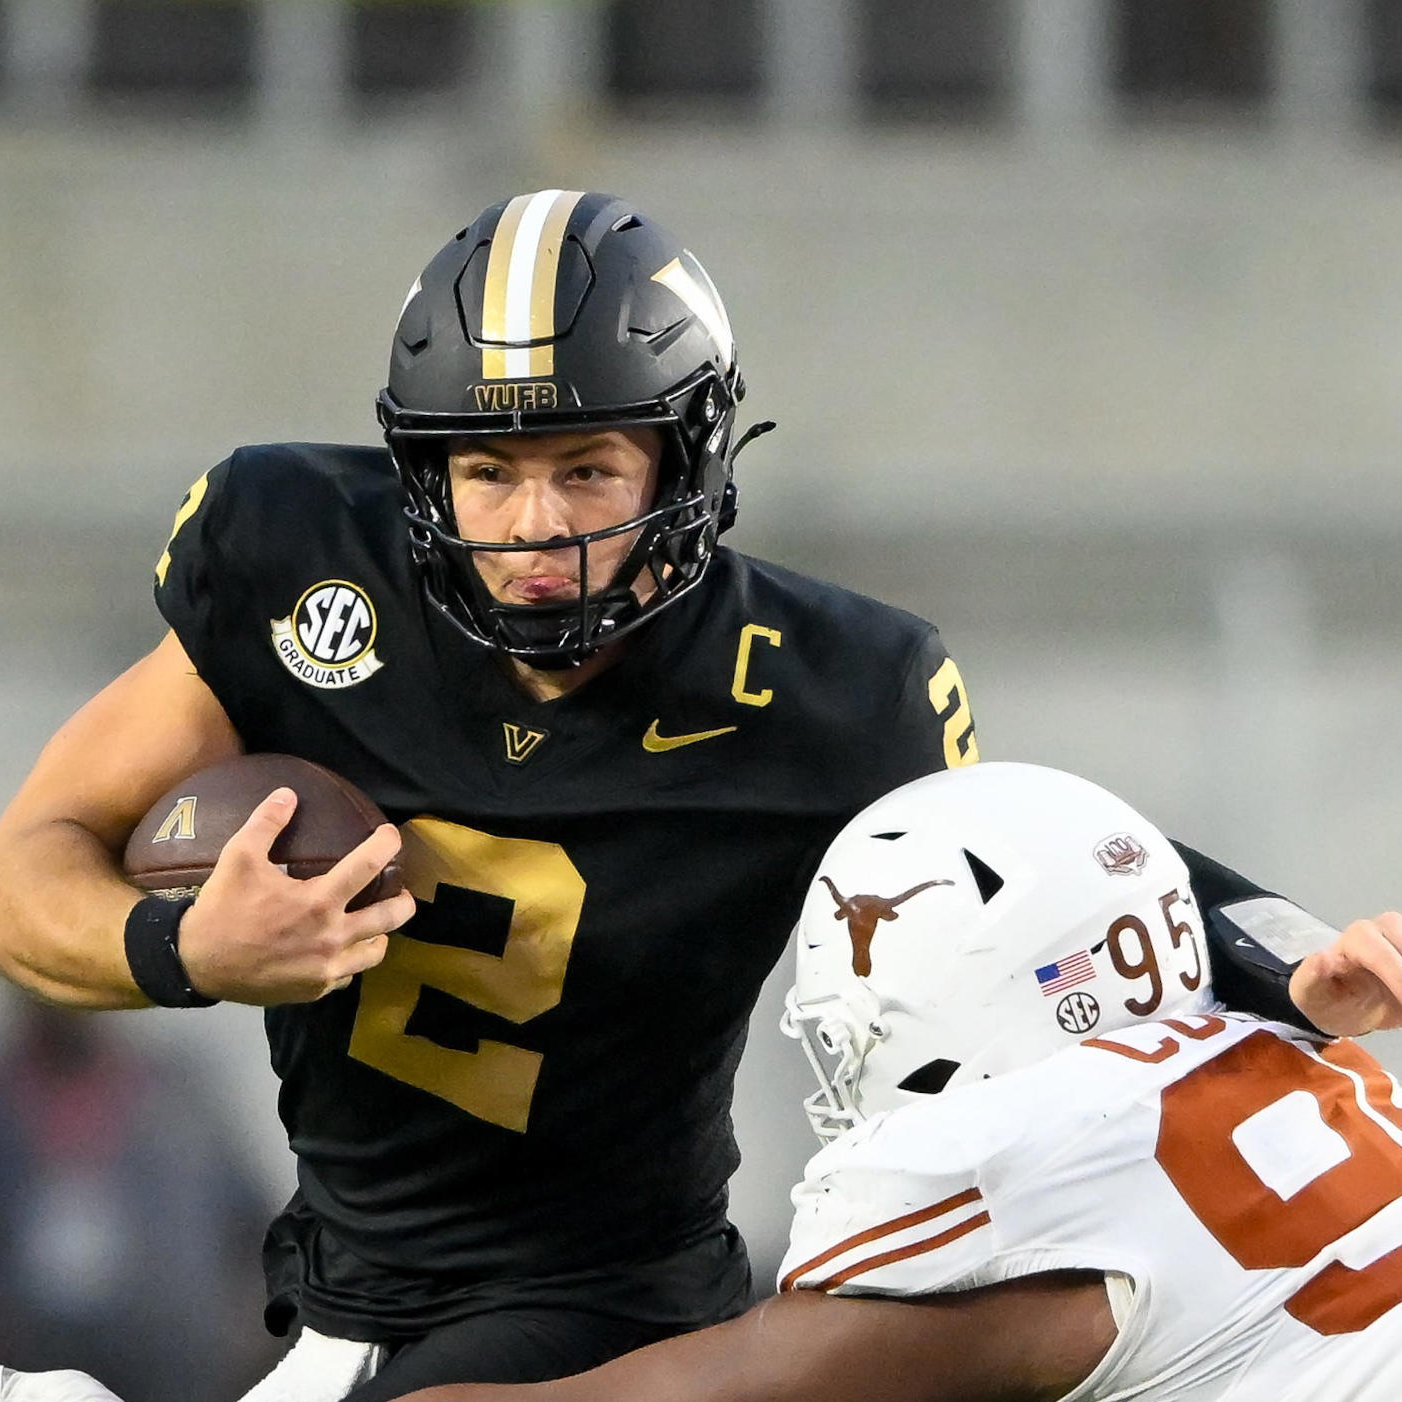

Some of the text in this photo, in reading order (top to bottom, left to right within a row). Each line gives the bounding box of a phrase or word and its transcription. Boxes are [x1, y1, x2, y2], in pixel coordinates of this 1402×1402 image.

[475, 382, 558, 411] VUFB
[299, 586, 371, 661] SEC
[279, 638, 361, 685] GRADUATE
[732, 623, 782, 707] C
[503, 723, 546, 762] V
[926, 656, 980, 769] 2
[347, 817, 584, 1134] 2
[1106, 888, 1202, 1017] 95
[1057, 991, 1100, 1034] SEC
